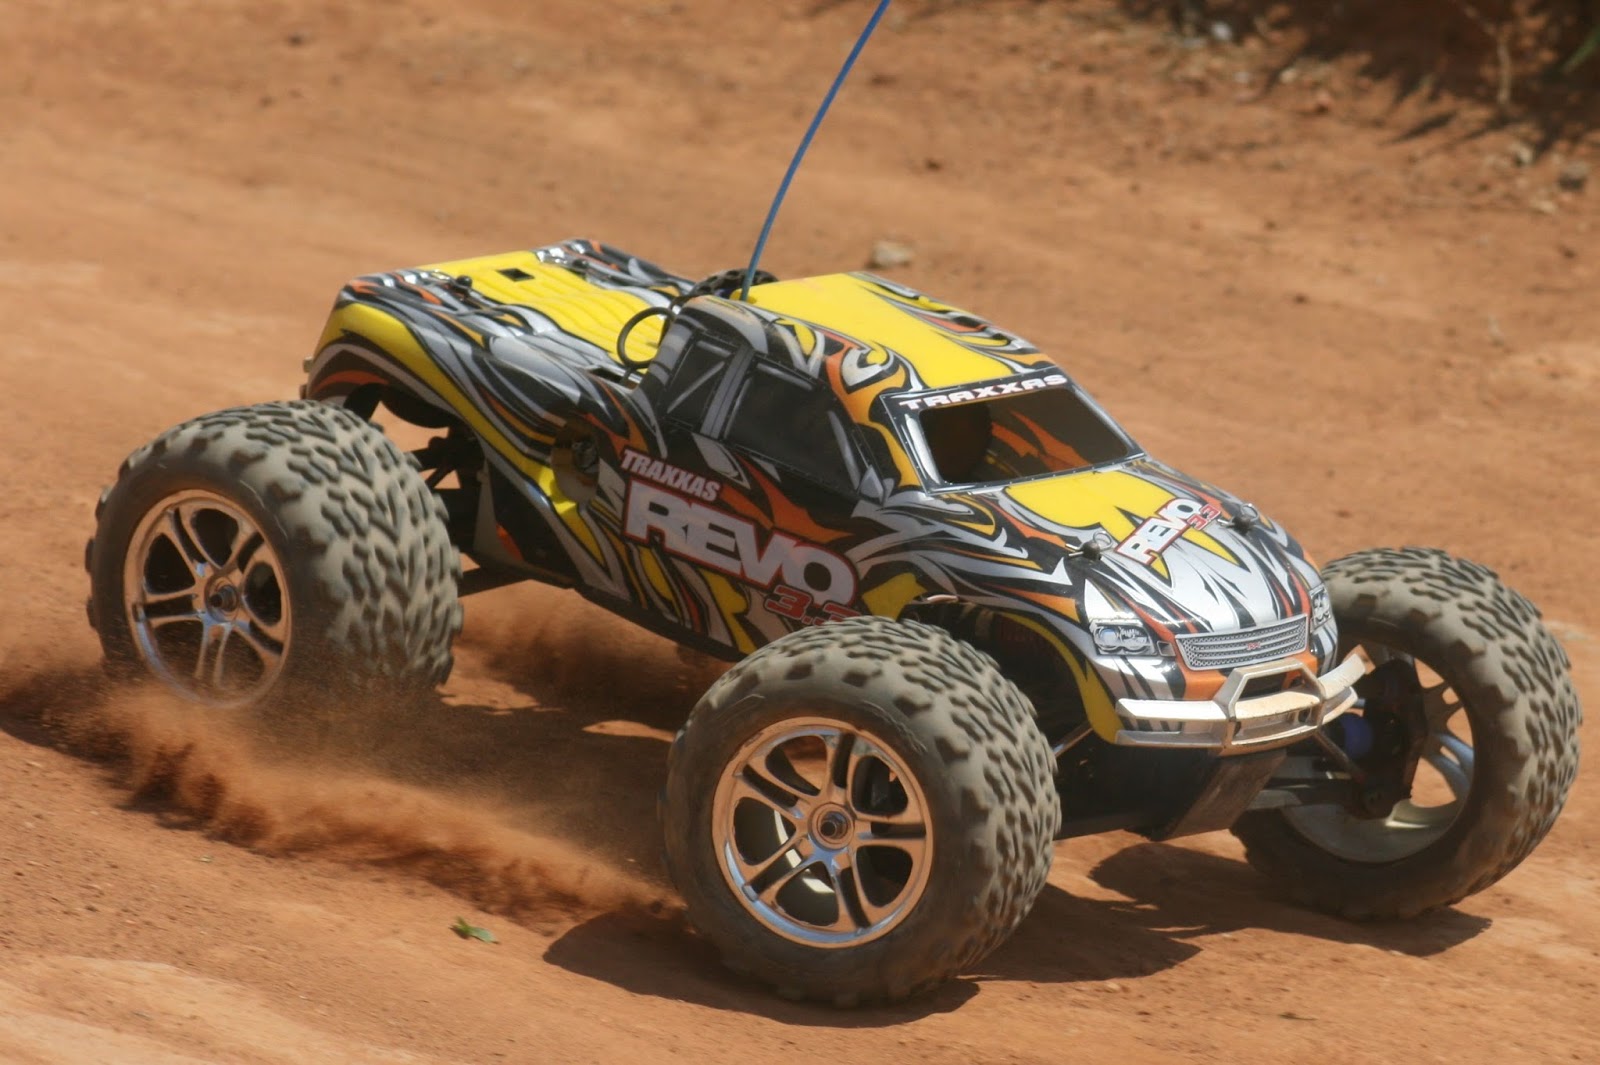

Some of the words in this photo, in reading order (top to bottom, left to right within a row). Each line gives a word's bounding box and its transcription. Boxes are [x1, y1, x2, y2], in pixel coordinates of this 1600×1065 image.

[899, 374, 1068, 410] TRAXXAS
[620, 449, 720, 501] TRAXXAS
[624, 479, 858, 606] REVO
[1116, 498, 1204, 566] REVO
